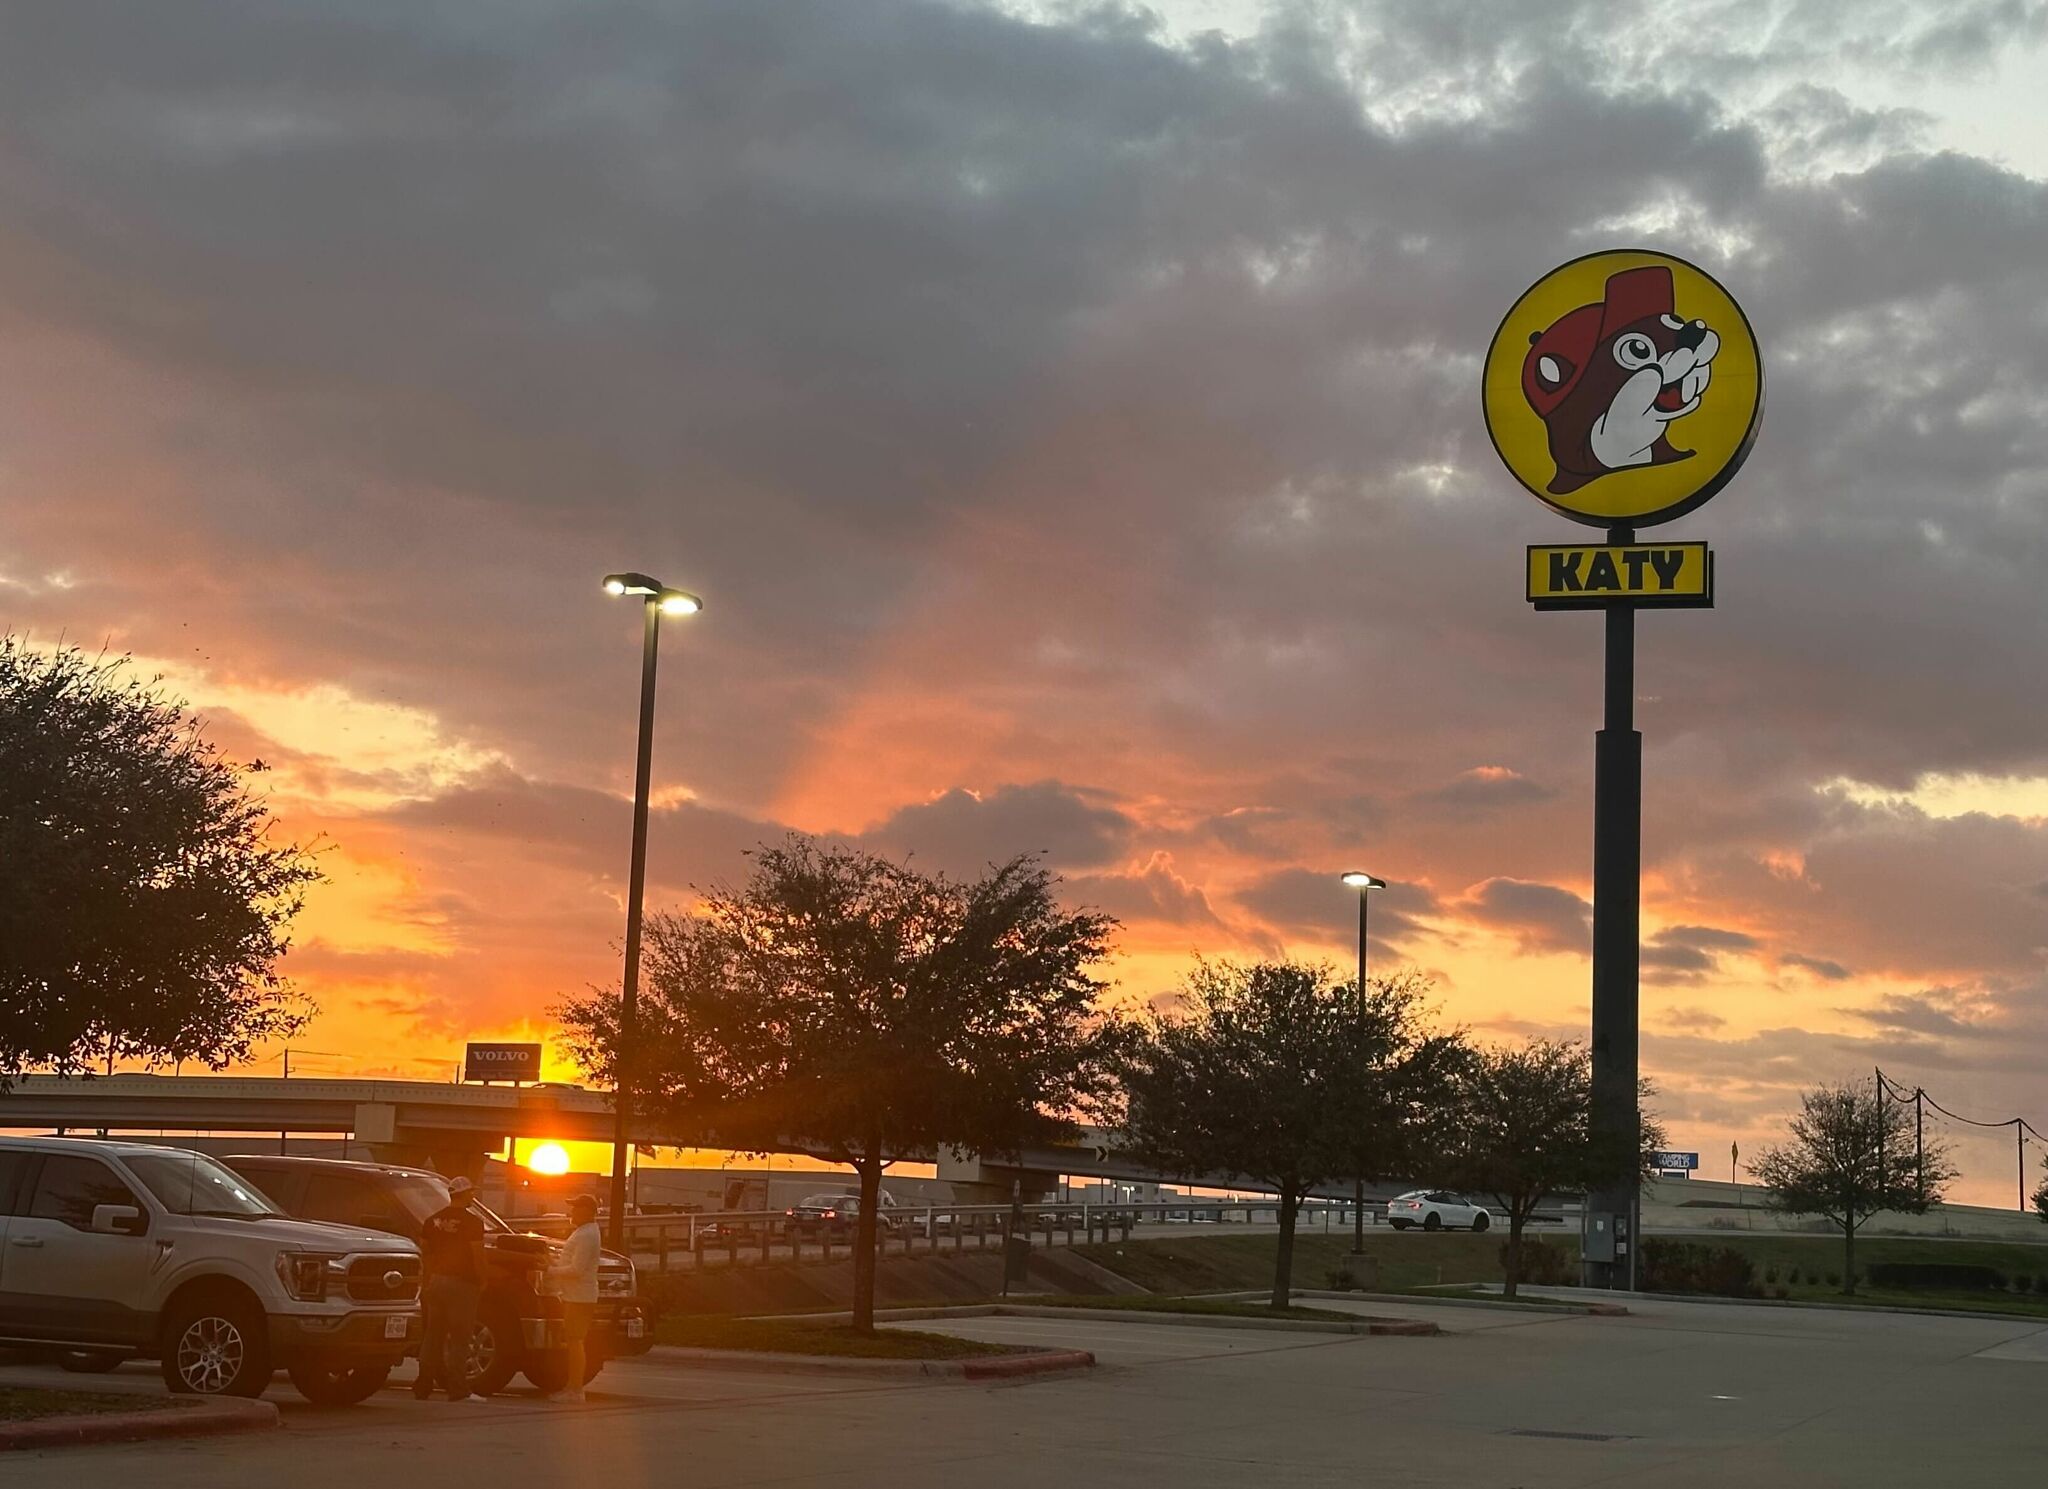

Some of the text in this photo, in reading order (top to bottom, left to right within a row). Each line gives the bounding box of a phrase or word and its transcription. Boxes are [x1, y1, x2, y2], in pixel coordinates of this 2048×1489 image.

[1549, 550, 1684, 592] KATY
[473, 1050, 530, 1061] VOLVO
[1659, 1159, 1690, 1168] WORLD
